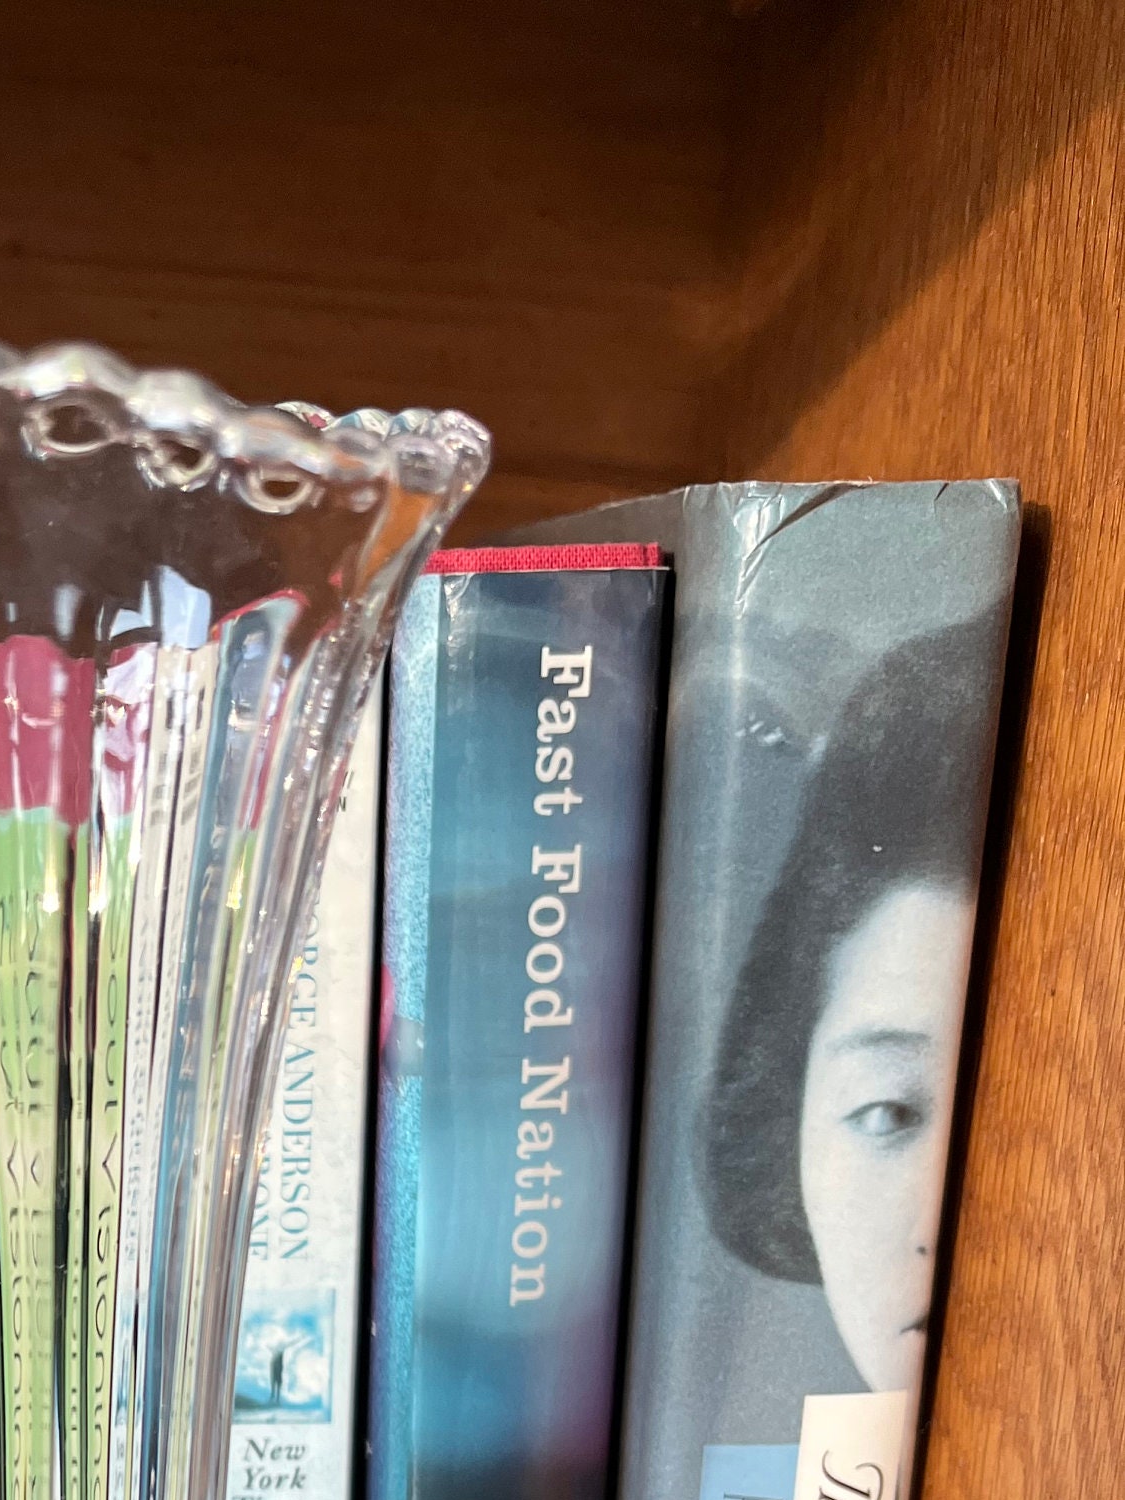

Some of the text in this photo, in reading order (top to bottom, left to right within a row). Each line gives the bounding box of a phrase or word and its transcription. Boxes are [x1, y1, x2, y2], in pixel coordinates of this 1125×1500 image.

[509, 644, 593, 1306] Fast Food Nation
[279, 1042, 315, 1262] ANDERSON
[244, 1437, 307, 1462] New
[244, 1466, 307, 1491] York
